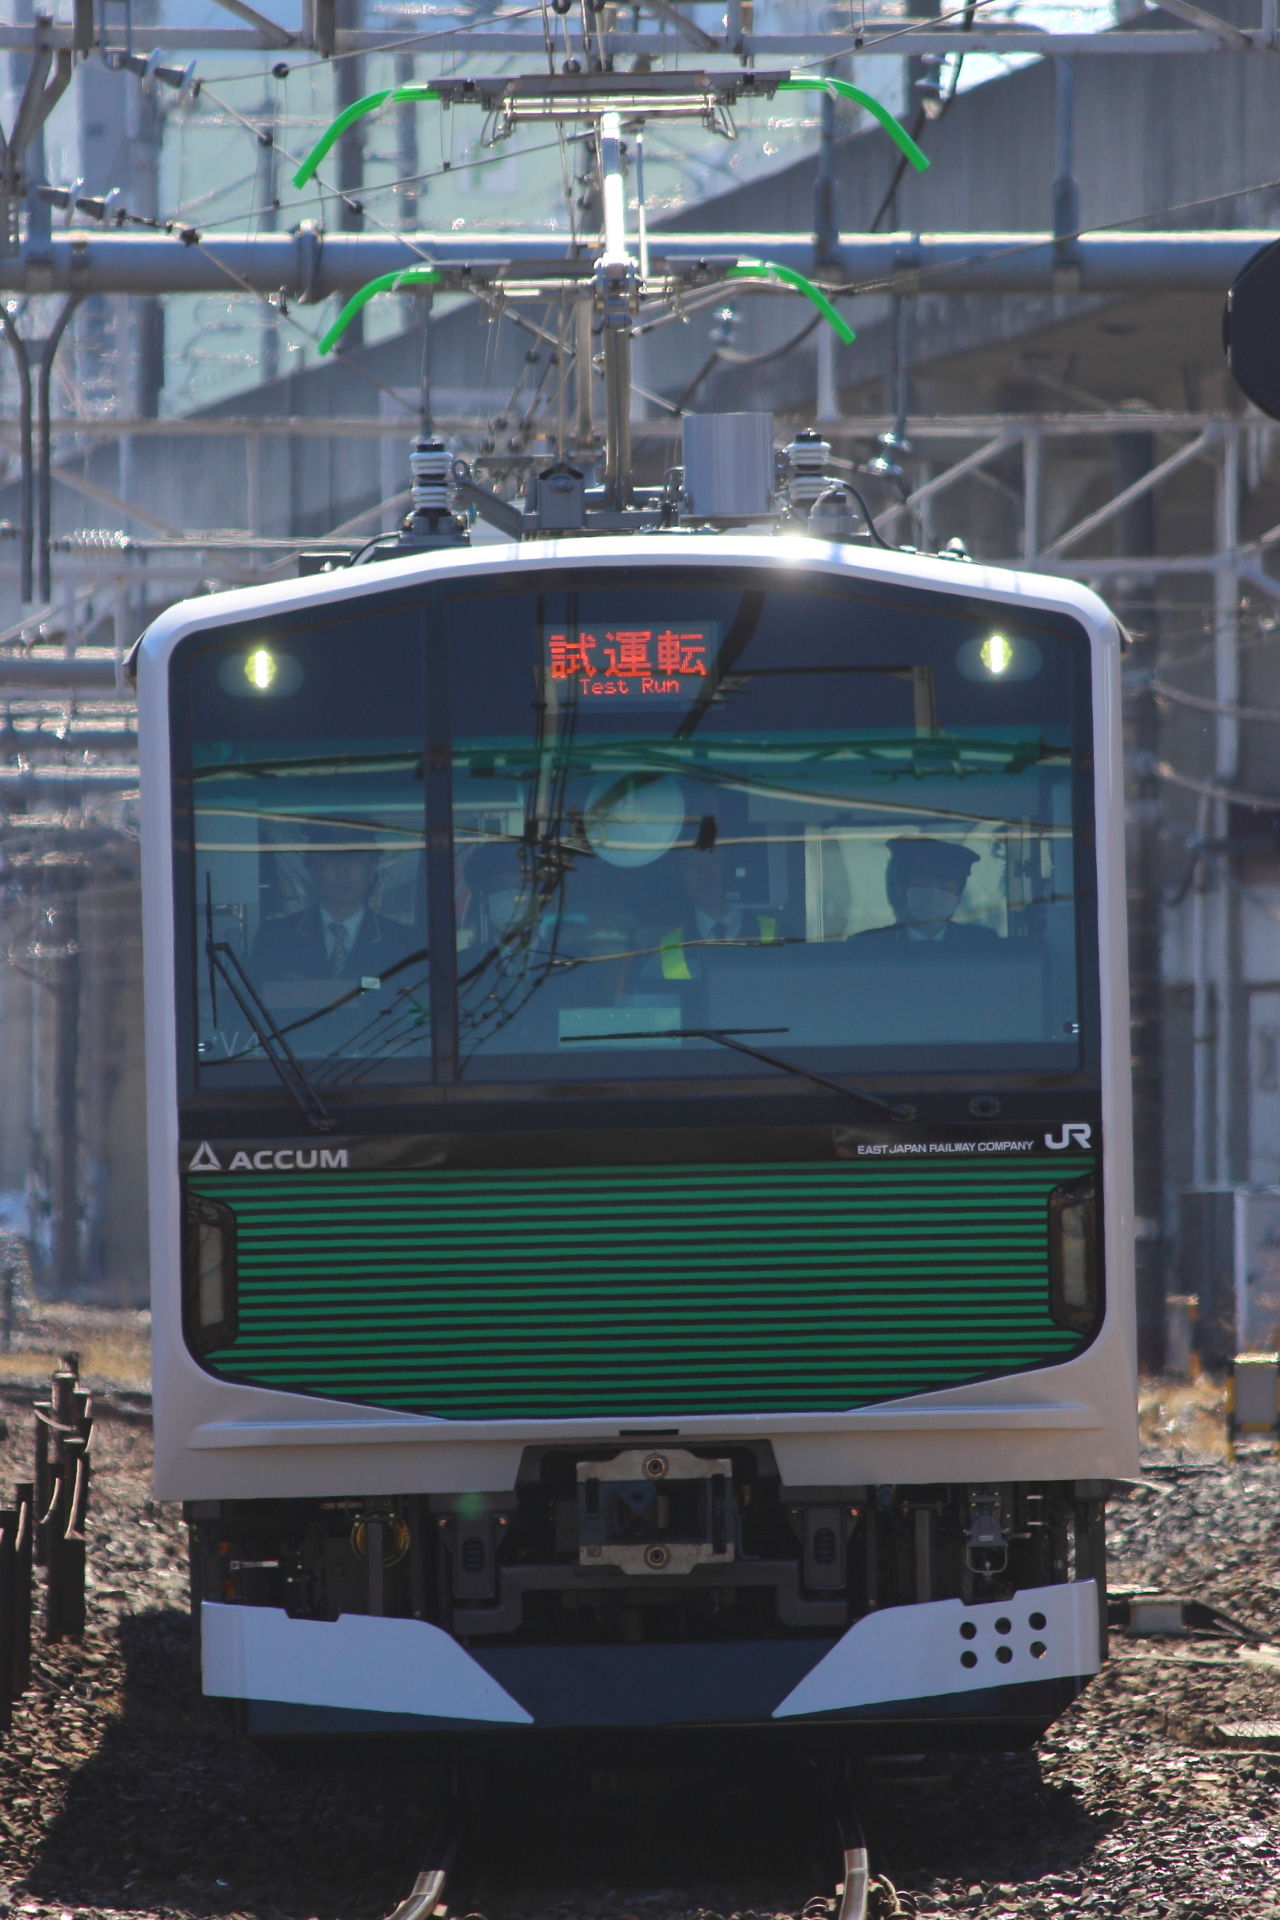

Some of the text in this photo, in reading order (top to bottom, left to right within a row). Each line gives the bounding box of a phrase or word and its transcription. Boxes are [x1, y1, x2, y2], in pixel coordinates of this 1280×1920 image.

[549, 630, 708, 679] 試運転
[579, 677, 681, 695] Test Run
[1044, 1123, 1092, 1150] JR
[857, 1140, 1034, 1155] EAST JAPAN RAILWAY COMPANY
[228, 1149, 349, 1170] ACCUM
